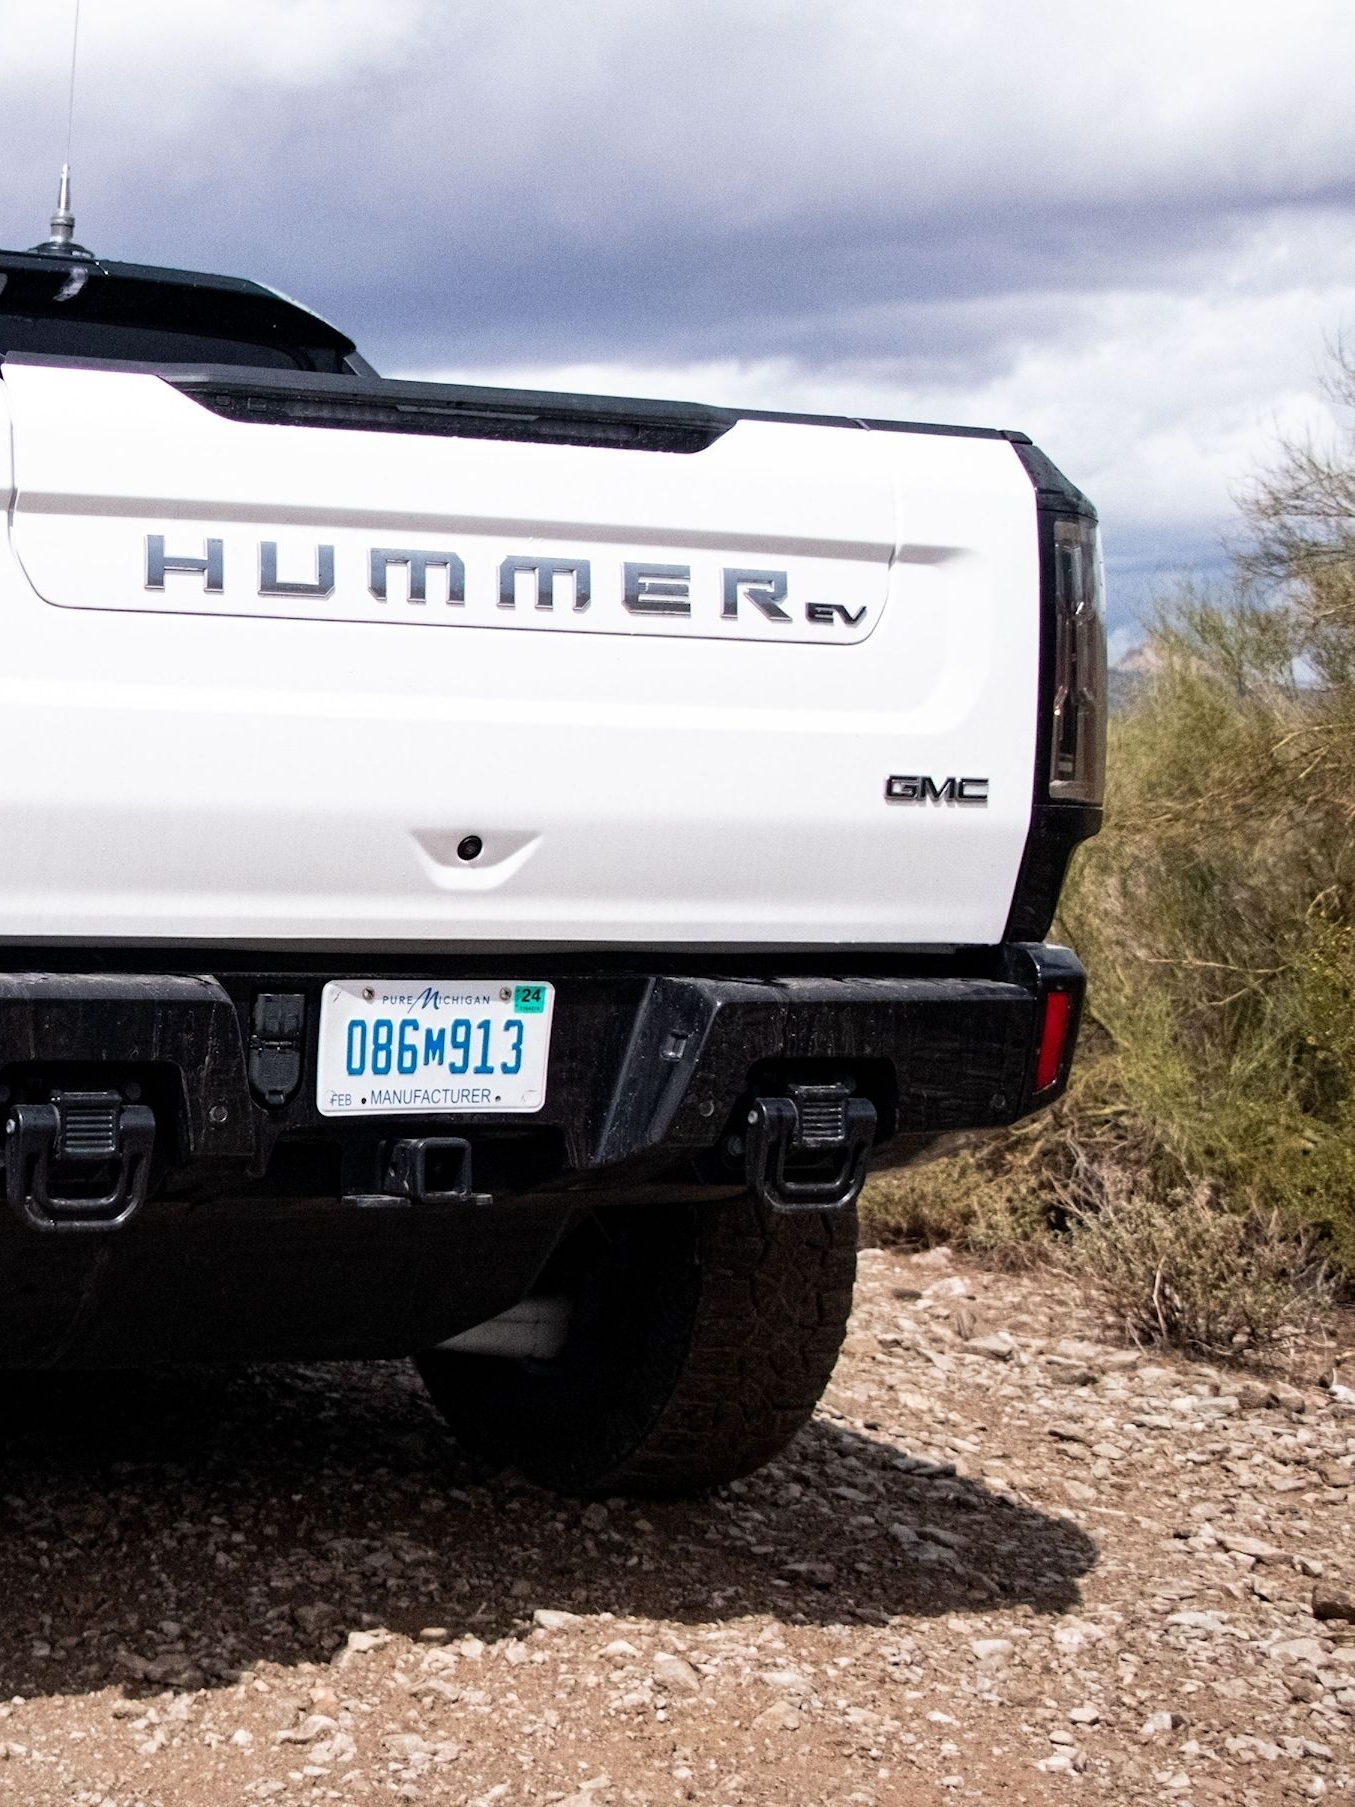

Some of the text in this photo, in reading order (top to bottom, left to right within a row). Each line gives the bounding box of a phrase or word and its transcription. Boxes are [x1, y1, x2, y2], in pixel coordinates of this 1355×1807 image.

[144, 534, 867, 627] HUMMER EV
[884, 775, 989, 804] GMC
[382, 987, 490, 1014] PURE MICHIGAN
[521, 988, 541, 1003] 24
[346, 1018, 524, 1076] 086M913
[330, 1093, 352, 1107] FEB
[370, 1088, 492, 1105] MANUFACTURER
